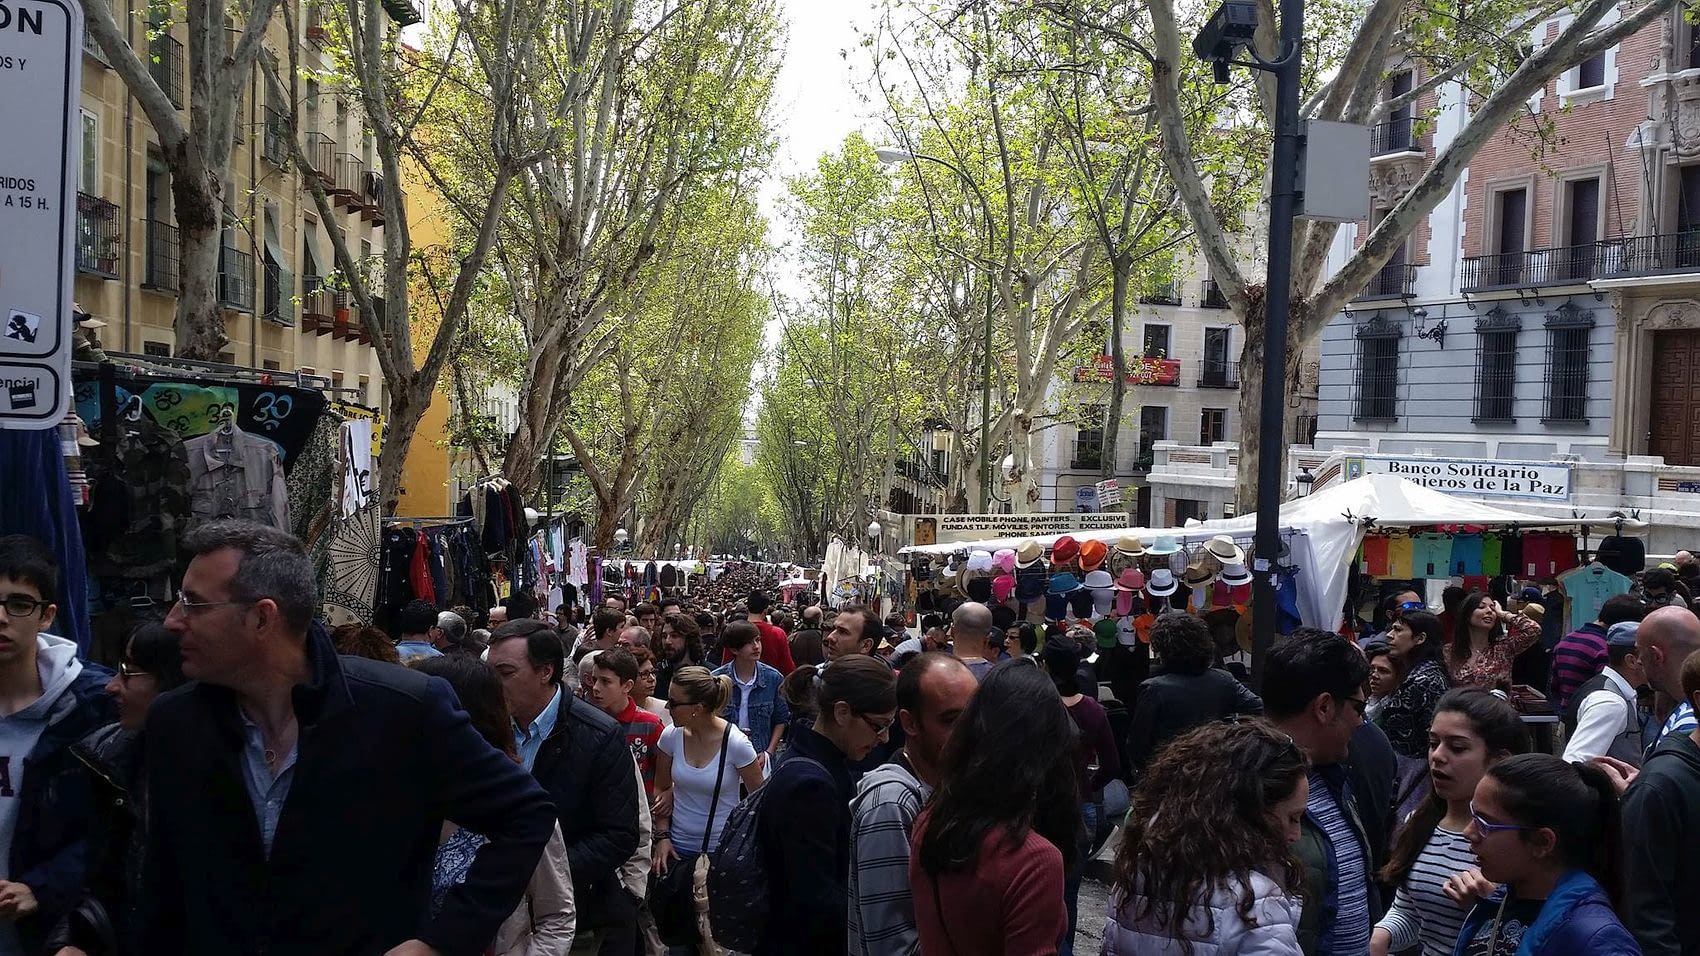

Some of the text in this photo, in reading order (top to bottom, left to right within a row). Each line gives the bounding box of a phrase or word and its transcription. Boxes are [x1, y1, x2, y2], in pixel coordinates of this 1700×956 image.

[18, 58, 27, 71] Y
[4, 194, 50, 211] A 15 H.
[1388, 461, 1539, 480] Banco Solidario
[1472, 478, 1497, 490] de
[1503, 479, 1521, 492] la
[1529, 480, 1565, 495] Paz
